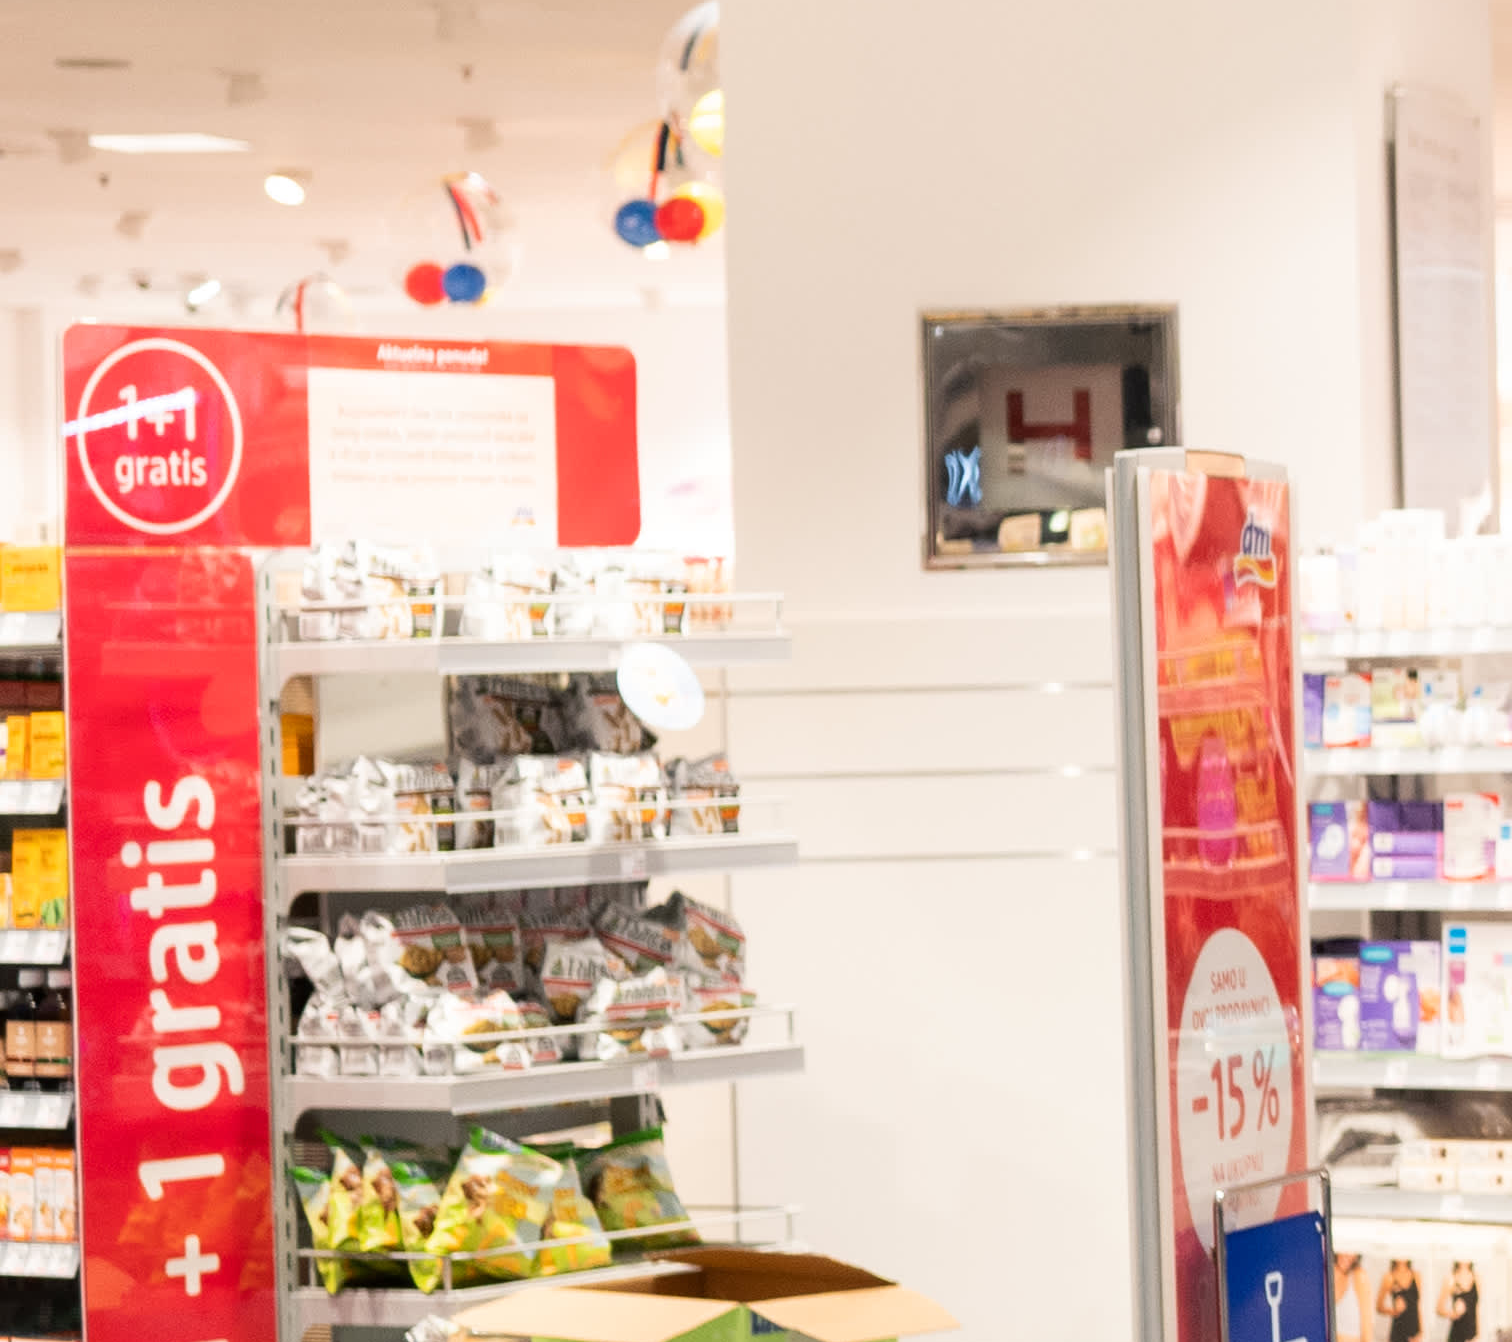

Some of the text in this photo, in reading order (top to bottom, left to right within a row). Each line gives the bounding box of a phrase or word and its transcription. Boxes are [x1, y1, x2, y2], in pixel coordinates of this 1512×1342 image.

[115, 447, 208, 495] gratis
[1242, 514, 1270, 556] dm
[120, 774, 245, 1111] gratis
